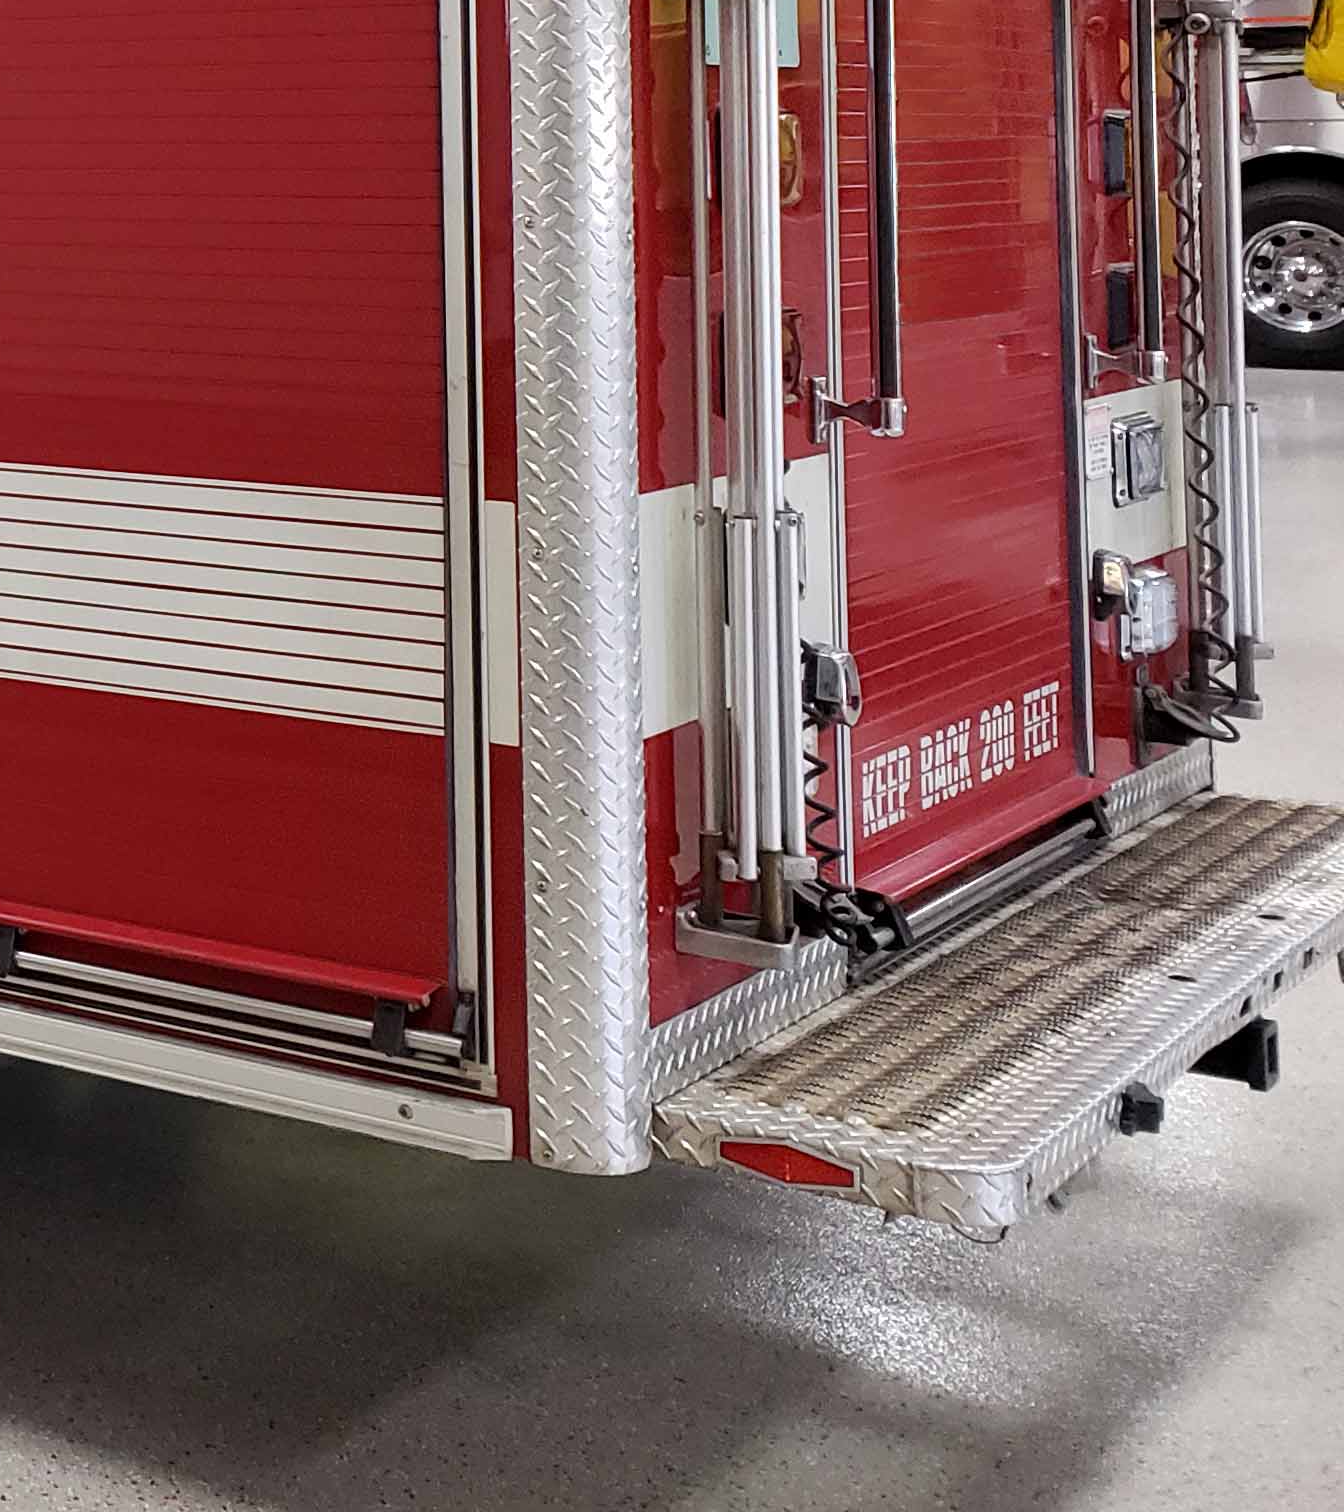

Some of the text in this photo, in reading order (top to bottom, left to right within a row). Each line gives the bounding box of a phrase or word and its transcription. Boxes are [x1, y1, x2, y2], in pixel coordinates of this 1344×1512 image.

[862, 681, 1060, 838] KEEP BACK 200 FEET
